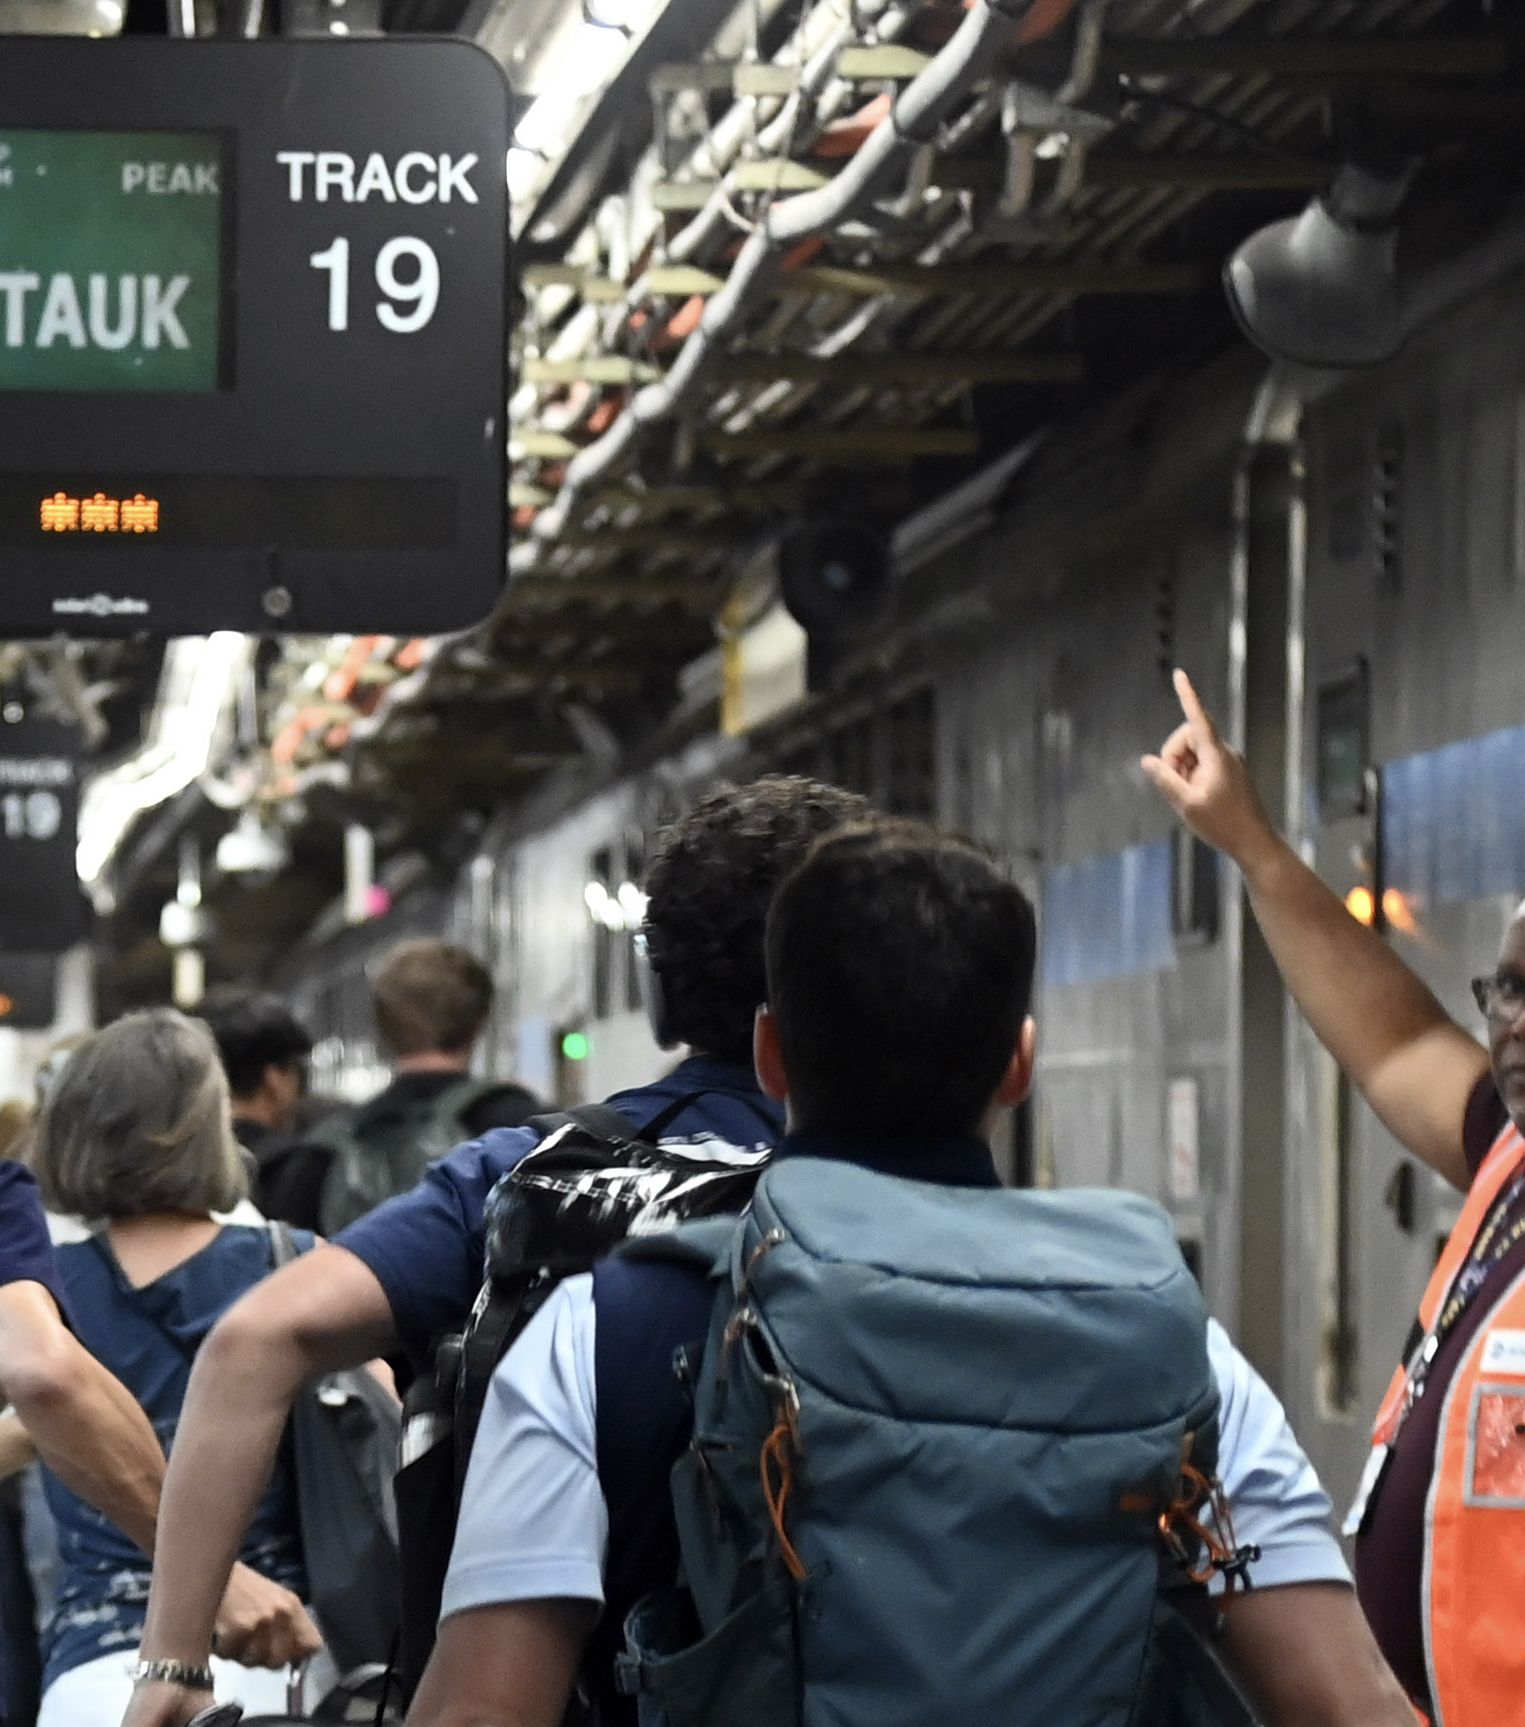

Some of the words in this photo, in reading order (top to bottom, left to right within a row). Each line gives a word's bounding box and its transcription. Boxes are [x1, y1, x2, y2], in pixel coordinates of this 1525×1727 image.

[120, 161, 222, 195] PEAK
[276, 151, 479, 204] TRACK
[310, 236, 441, 333] 19
